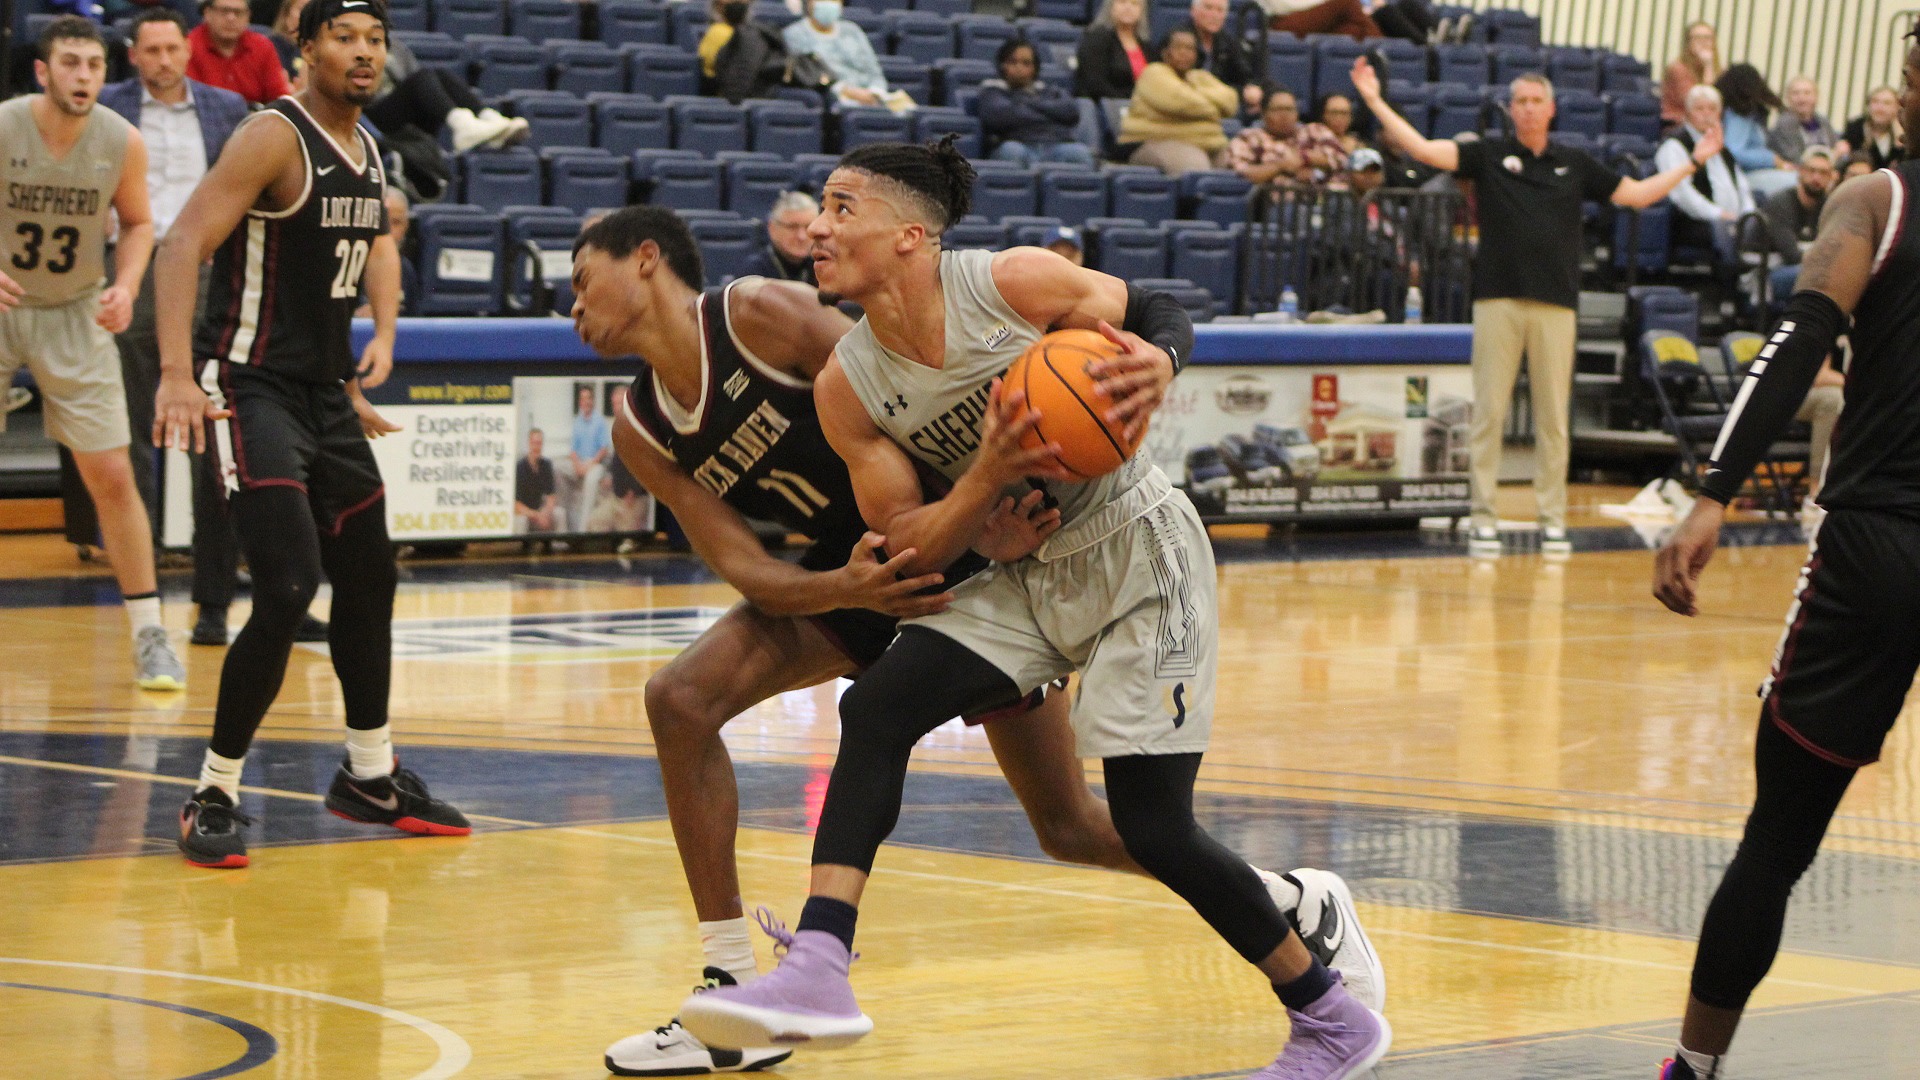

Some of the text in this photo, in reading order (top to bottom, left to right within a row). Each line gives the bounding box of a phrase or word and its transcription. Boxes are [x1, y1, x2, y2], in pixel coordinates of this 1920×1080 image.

[7, 181, 98, 215] SHEPHERD
[320, 196, 381, 229] LOCK HAVE
[11, 221, 80, 273] 33
[331, 239, 369, 298] 20
[417, 413, 509, 437] Expertise.
[719, 398, 791, 473] HAVEN
[411, 438, 509, 461] Creativity.
[410, 462, 509, 481] Resilience.
[435, 486, 508, 505] Results.
[756, 467, 831, 519] 11
